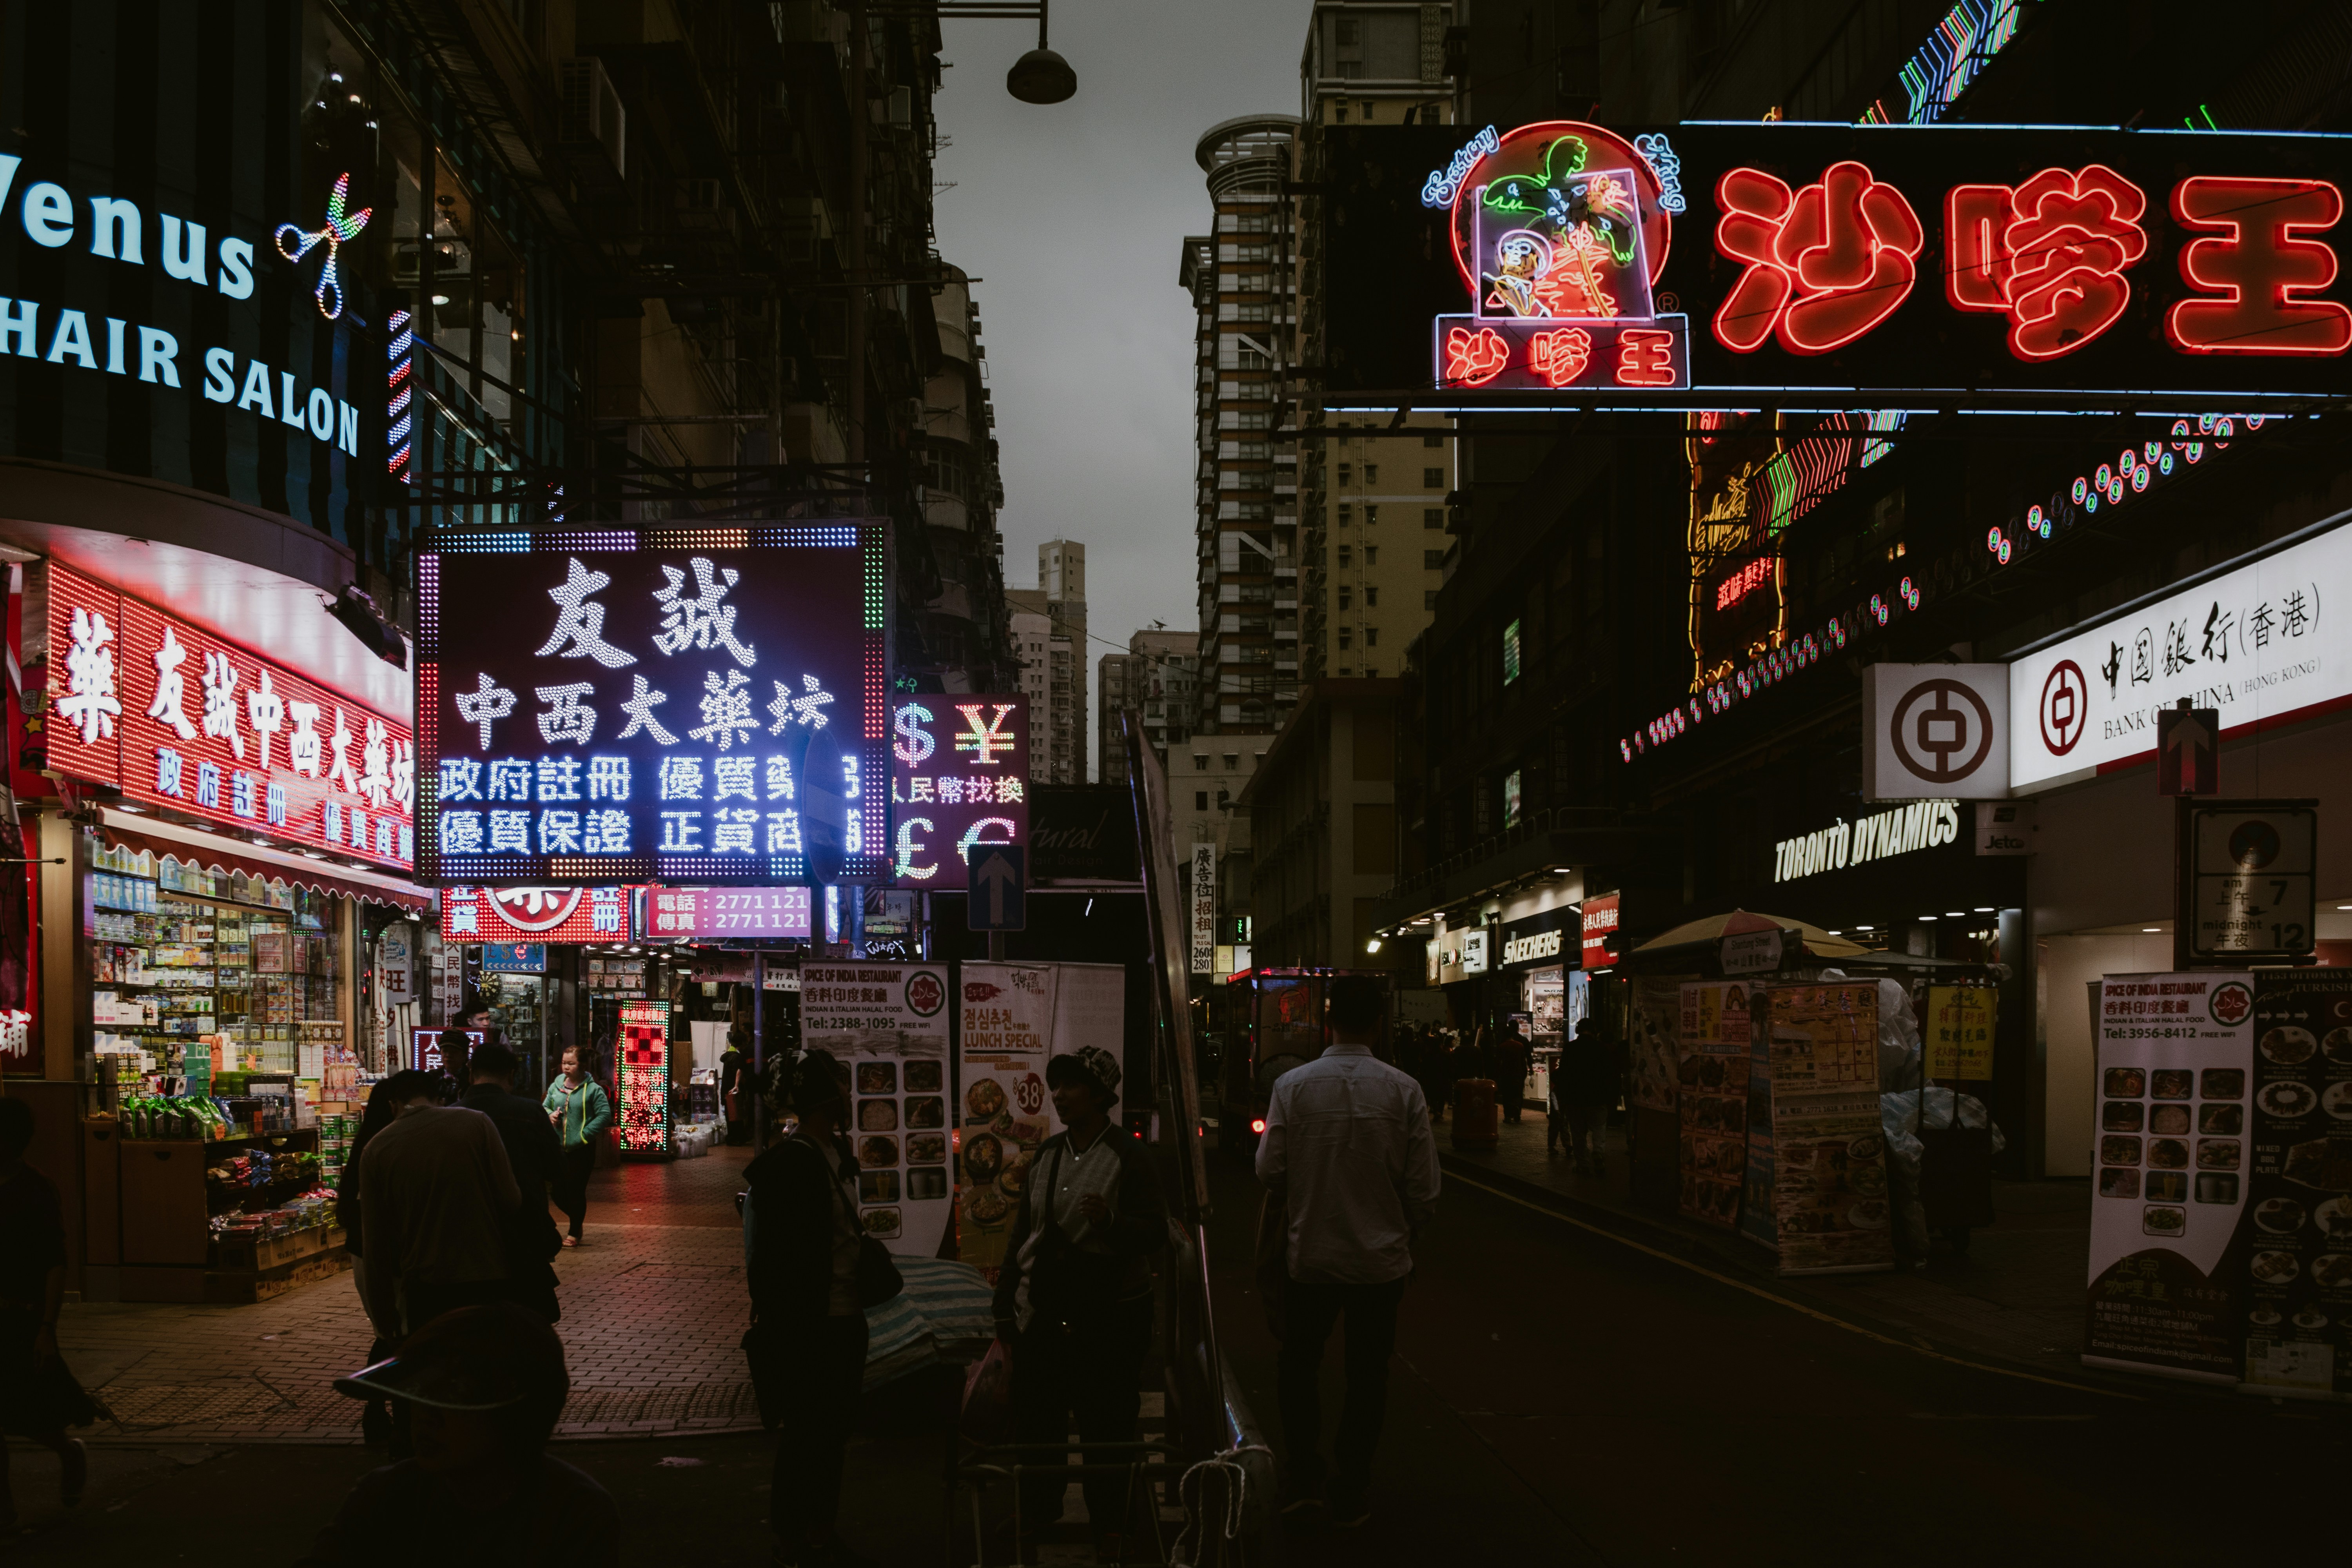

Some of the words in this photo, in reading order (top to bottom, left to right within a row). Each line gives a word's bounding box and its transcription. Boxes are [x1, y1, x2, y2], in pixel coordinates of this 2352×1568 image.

[1711, 160, 2352, 363] 沙嗲王
[0, 297, 181, 389] HAIR
[205, 347, 358, 457] SALON
[535, 557, 757, 668] 友誠
[58, 607, 122, 744] 藥
[455, 668, 835, 752] 中西大藥坊
[2103, 716, 2146, 740] BANK
[2191, 685, 2235, 710] HINA
[158, 748, 286, 828] 政府註冊
[439, 757, 632, 801] 政府註冊
[439, 810, 631, 855] 優質保證
[1985, 835, 2024, 849] Jetco
[1775, 822, 1850, 883] TORONTO
[1851, 802, 1960, 864] DYNAMICS
[1195, 847, 1212, 932] 廣告位招租
[2216, 891, 2250, 906] 上午
[2223, 879, 2242, 887] am
[2269, 880, 2287, 906] 7
[716, 895, 765, 909] 2771
[771, 895, 810, 909] 121
[716, 913, 765, 928] 2771
[771, 913, 810, 928] 121
[1755, 937, 1770, 947] Street
[2203, 919, 2262, 931] midnight
[2271, 924, 2304, 948] 12
[2216, 933, 2250, 947] 午夜
[1503, 929, 1562, 965] SKECHERS
[1194, 958, 1212, 970] 280
[804, 969, 823, 982] SPICE
[825, 969, 835, 982] OF
[836, 969, 857, 982] INDIA
[858, 969, 902, 983] RESTAURANT
[2105, 984, 2126, 996] SPICE
[2127, 984, 2136, 996] OF
[2137, 983, 2158, 996] INDIA
[2160, 982, 2207, 995] RESTAURANT
[806, 1018, 828, 1029] Tel:
[830, 1018, 895, 1029] 2388-1095
[2104, 1028, 2127, 1039] Tel:
[2129, 1027, 2196, 1038] 3956-8412
[964, 1033, 1002, 1047] LUNCH
[1005, 1033, 1043, 1048] SPECIAL
[2116, 1256, 2160, 1279] 正宗
[2183, 1287, 2229, 1301] 設有堂食
[2095, 1301, 2131, 1313] 營業時間
[2172, 1340, 2198, 1348] Kowloon
